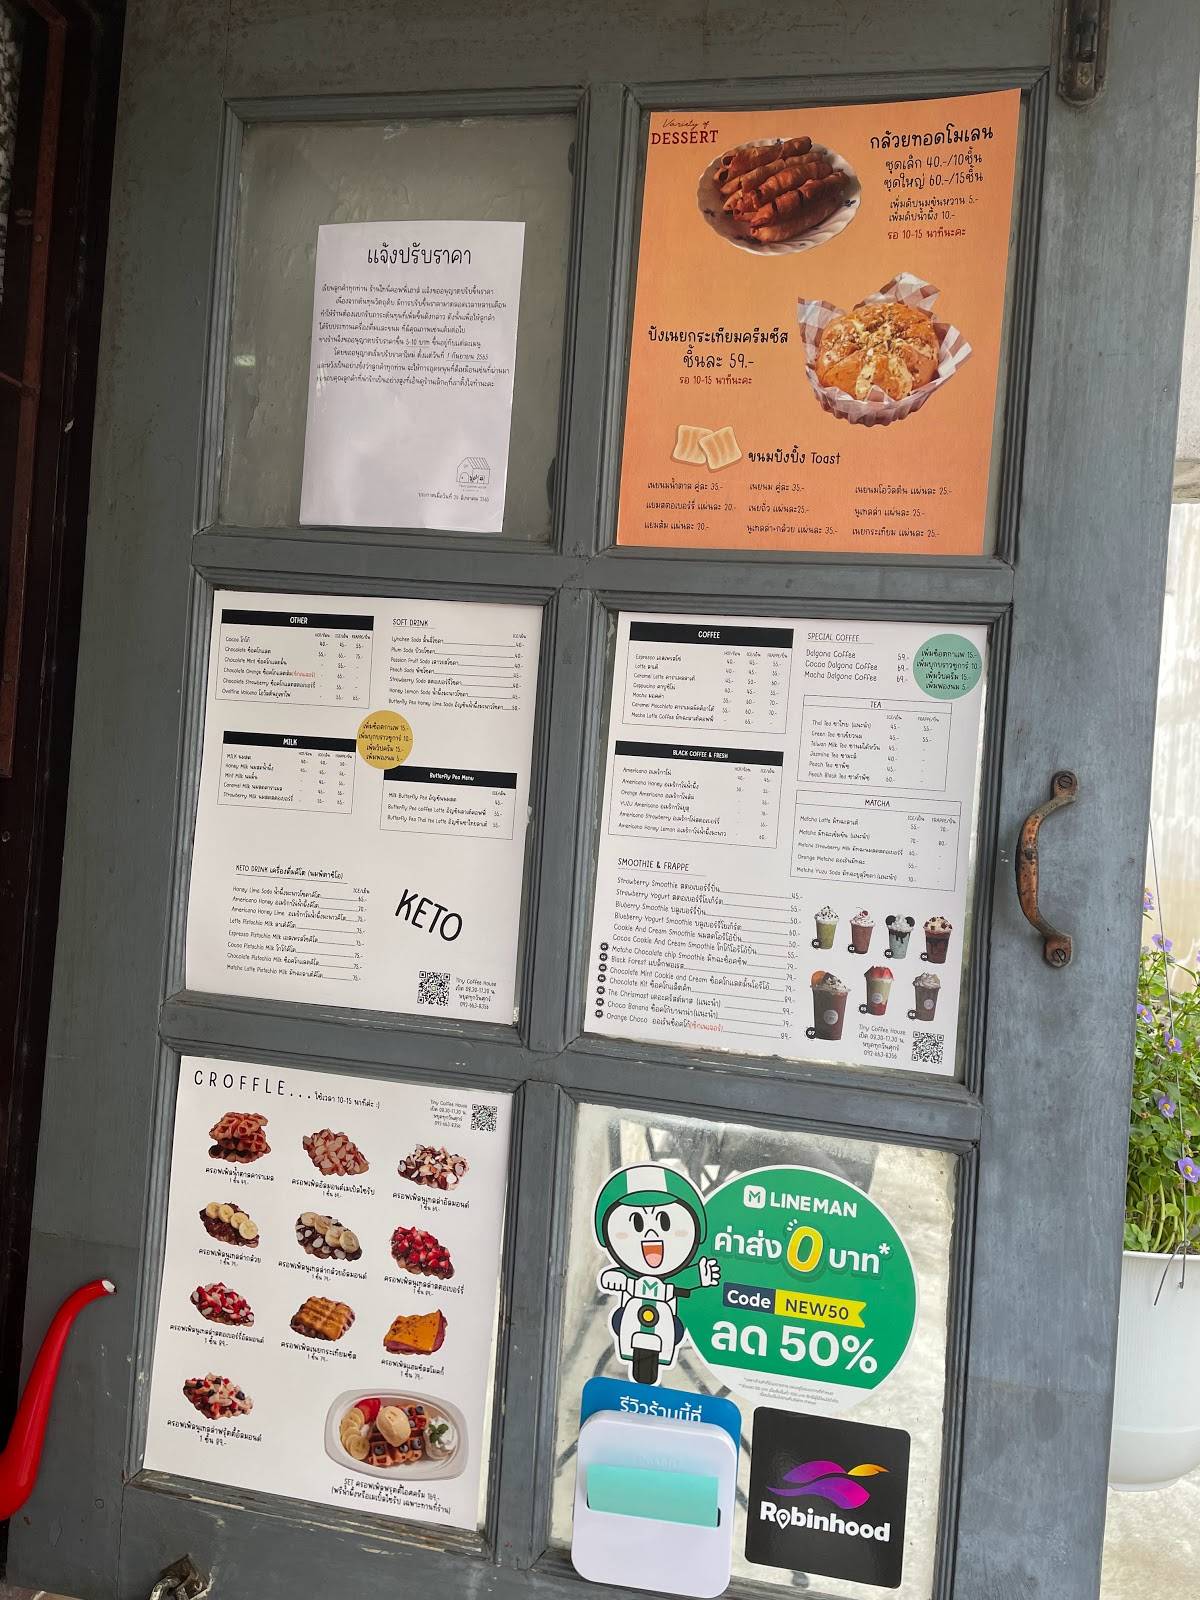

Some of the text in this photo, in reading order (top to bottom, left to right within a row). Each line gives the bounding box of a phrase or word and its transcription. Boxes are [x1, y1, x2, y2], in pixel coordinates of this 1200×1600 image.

[663, 119, 710, 131] Variety of
[651, 130, 719, 145] DESSERT
[870, 123, 993, 149] กล้วยทอดโมเลน
[885, 146, 983, 174] ชุดเล็ก 40.-/10ชิ้น
[883, 165, 984, 192] ชุดใหญ่ 60.-/15ชิ้น
[941, 210, 955, 220] 10.-
[887, 231, 899, 240] รอ
[902, 229, 923, 239] 10-15
[367, 241, 472, 265] แจ้งปรับราคา
[683, 344, 755, 369] ชิ้นละ 59.-
[679, 376, 690, 385] รอ
[693, 375, 713, 385] 10-15
[748, 445, 841, 465] ขนมปังปิ้ง Toast
[791, 483, 805, 492] 35.-
[939, 487, 953, 496] 25.-
[912, 509, 926, 518] 25.-
[825, 526, 839, 535] 35.-
[289, 616, 308, 625] OTHER
[392, 618, 429, 627] SOFT DRINK
[698, 630, 721, 640] COFFEE
[807, 632, 860, 642] SPECIAL COFFEE
[806, 649, 831, 659] Dalgona
[833, 650, 856, 659] Coffee
[805, 660, 826, 669] Cocoa
[827, 661, 853, 671] Dalgona
[855, 662, 878, 671] Coffee
[827, 672, 852, 682] Dalgona
[854, 673, 877, 683] Coffee
[870, 701, 882, 709] TEA
[282, 737, 298, 747] MILK
[672, 749, 689, 757] BLACK
[689, 750, 707, 758] COFFEE
[713, 751, 729, 760] FRESH
[429, 772, 475, 782] Butterfly Pea Menu
[864, 799, 891, 808] MATCHA
[235, 864, 269, 874] KETO DRINK
[617, 858, 654, 869] SMOOTHIE
[663, 861, 690, 872] FRAPPE
[617, 877, 650, 887] Strawberry
[651, 879, 678, 889] Smoothie
[616, 888, 649, 899] Strawberry
[650, 892, 671, 901] Yogurt
[642, 903, 669, 912] Smoothie
[394, 888, 463, 942] KETO
[614, 912, 643, 922] Blueberry
[644, 915, 664, 924] Yogurt
[665, 917, 693, 926] Smoothie
[613, 923, 633, 931] Cookie
[635, 925, 647, 933] And
[648, 926, 668, 935] Cream
[668, 929, 696, 938] Smoothie
[337, 1096, 352, 1106] 10-15
[713, 1225, 782, 1260] ค่าส่ง
[787, 1224, 824, 1273] 0
[726, 1289, 850, 1321] Code NEW50
[710, 1319, 879, 1375] ลด 50%
[759, 1501, 891, 1542] Robinhood
